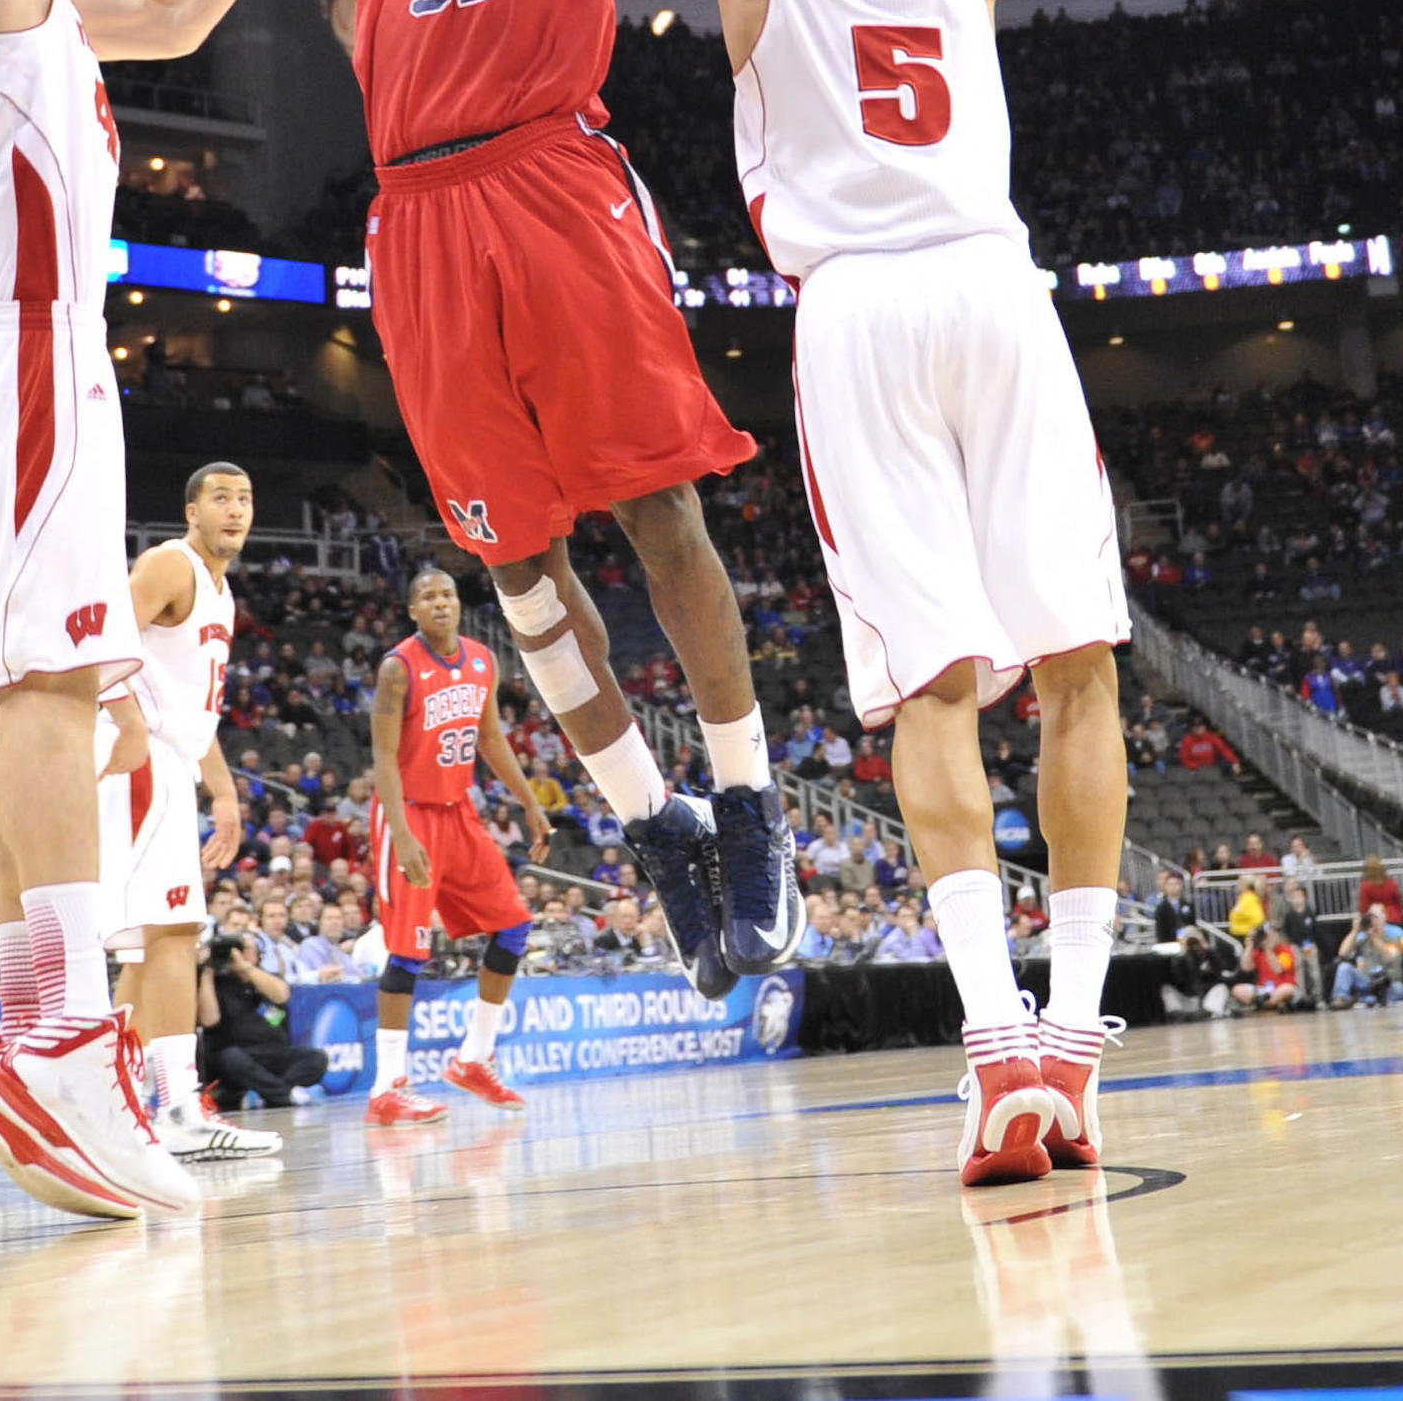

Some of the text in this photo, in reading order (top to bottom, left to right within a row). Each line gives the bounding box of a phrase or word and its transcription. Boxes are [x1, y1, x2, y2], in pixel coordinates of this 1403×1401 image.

[851, 25, 951, 147] 5
[66, 602, 107, 647] W
[436, 725, 479, 767] 32
[413, 1000, 518, 1040] SECOD
[522, 994, 574, 1032] AND
[576, 989, 642, 1029] THIRD
[325, 1042, 364, 1073] CAA
[701, 1028, 745, 1059] HOST
